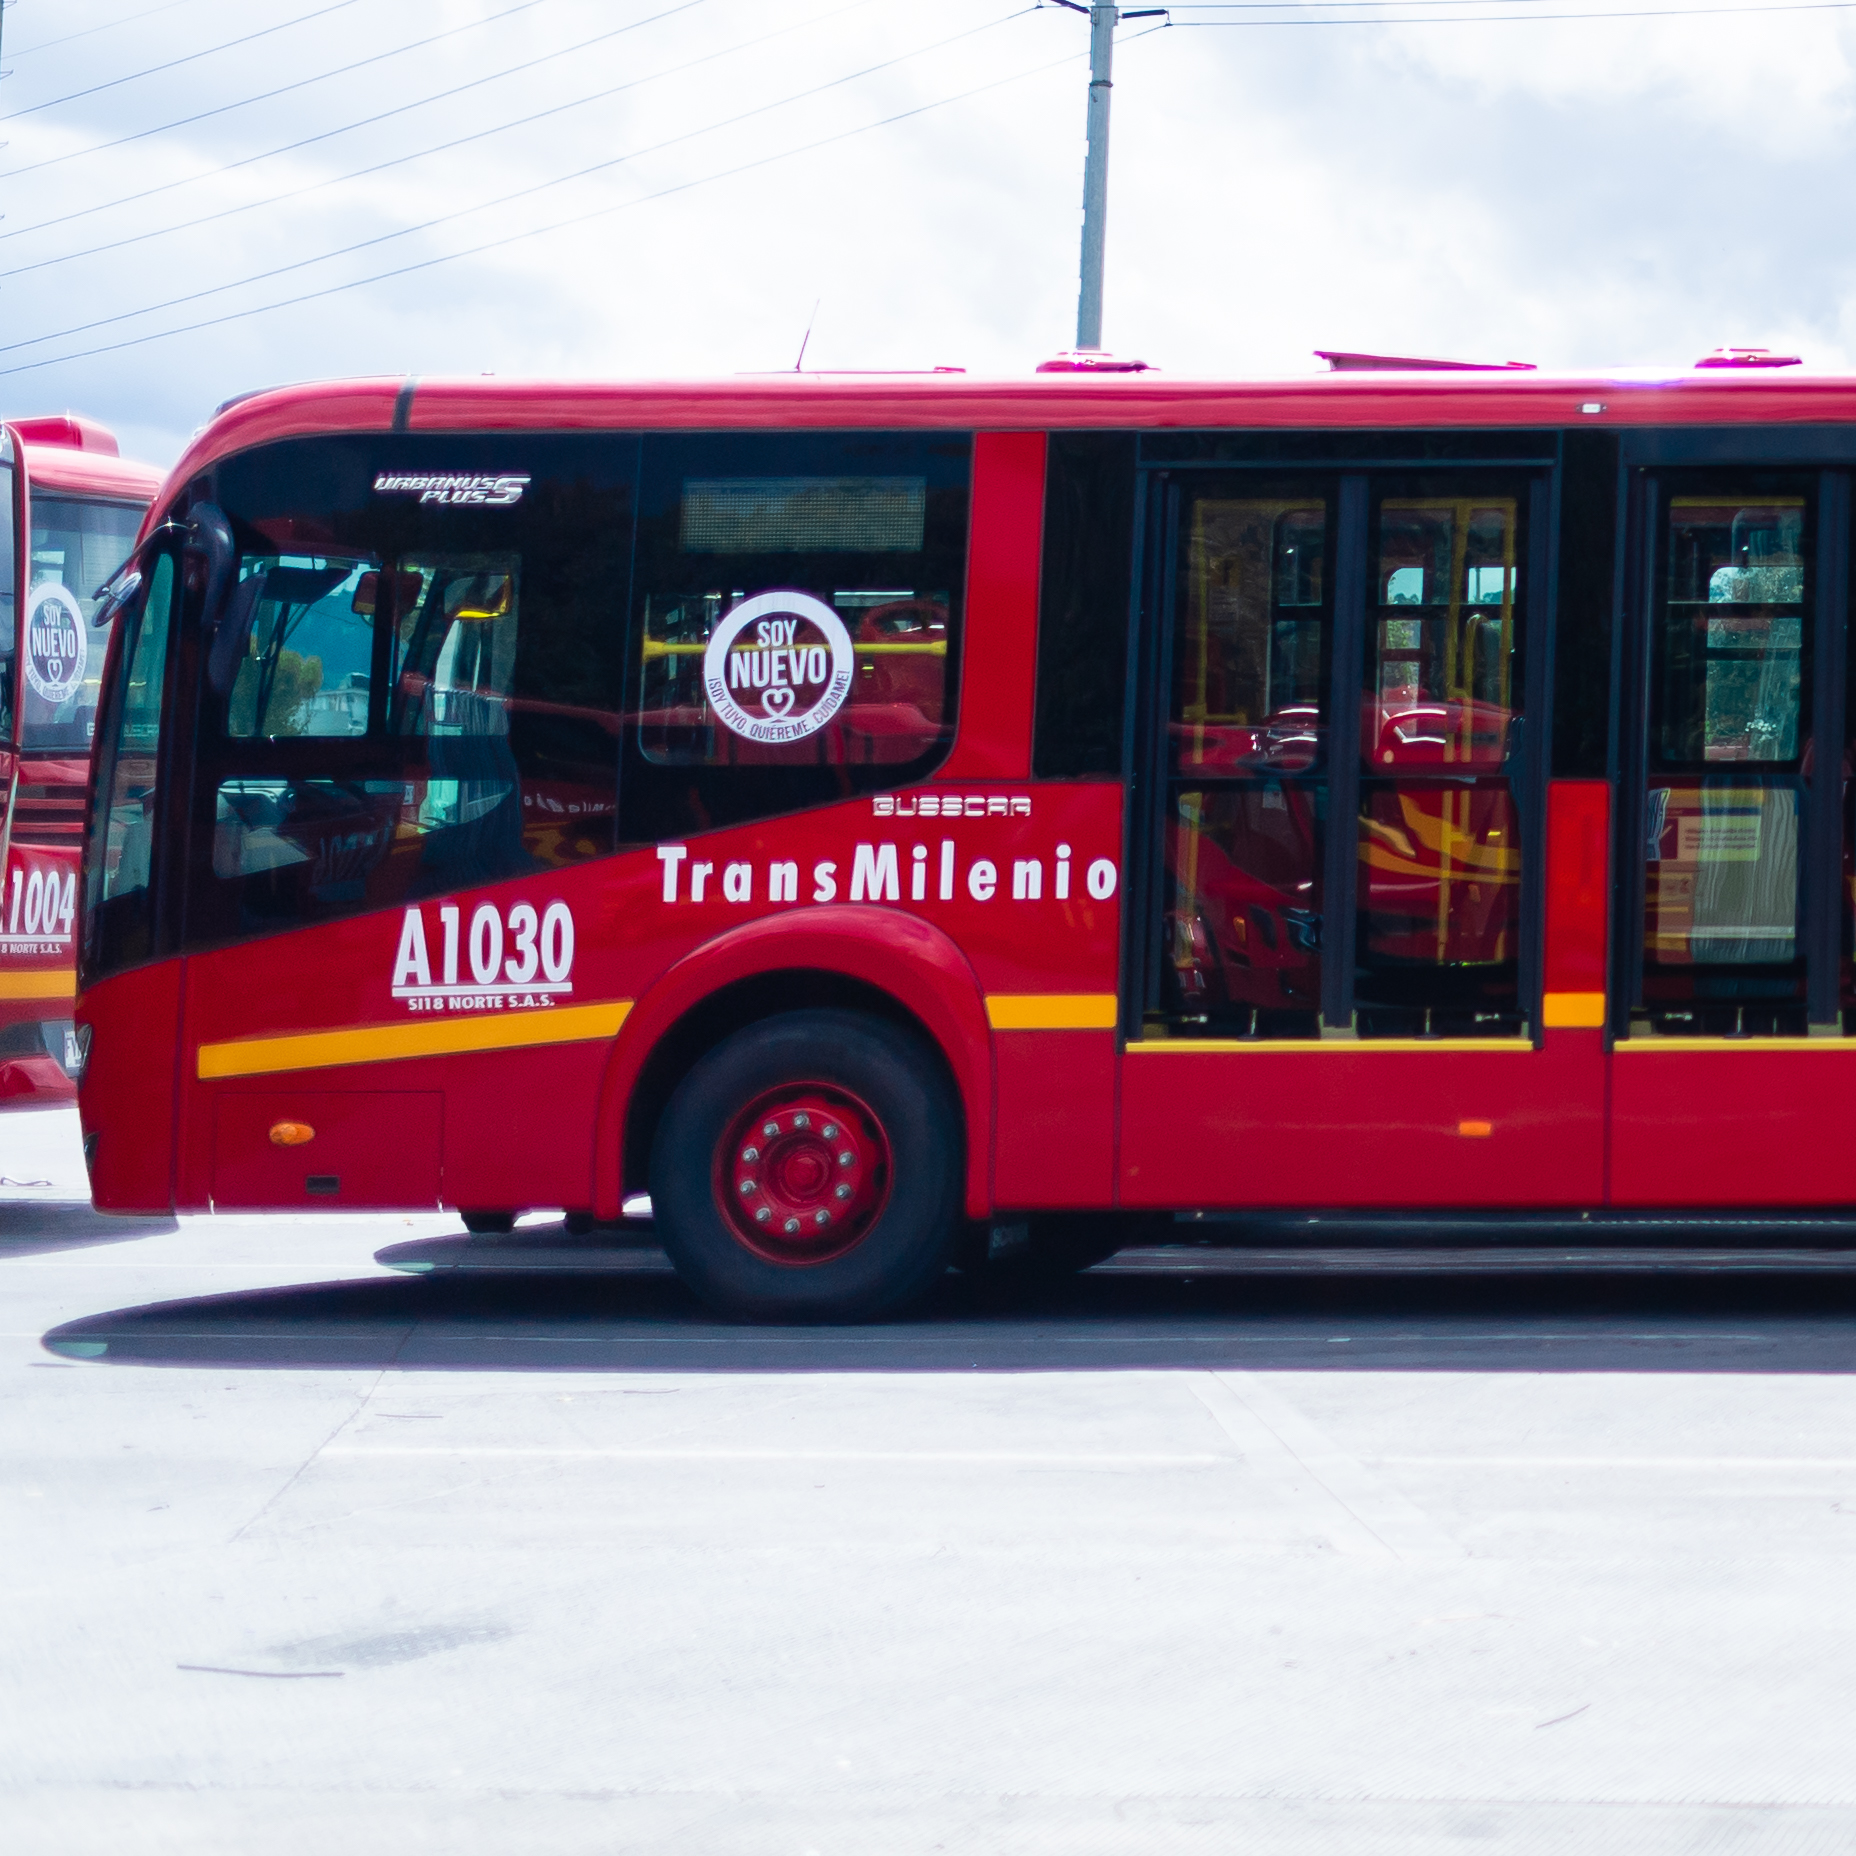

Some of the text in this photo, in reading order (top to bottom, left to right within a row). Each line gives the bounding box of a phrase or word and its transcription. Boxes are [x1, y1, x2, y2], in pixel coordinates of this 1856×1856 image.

[43, 605, 62, 626] SOY
[32, 627, 76, 658] NUEVO
[757, 619, 798, 647] SOY
[731, 647, 827, 689] NUEVO
[873, 795, 1031, 817] BUSSCAR
[657, 841, 1117, 902] TransMilenio
[0, 870, 76, 935] 1004
[10, 944, 38, 954] NORTE
[392, 903, 574, 985] A1030
[449, 995, 504, 1009] NORTE
[508, 993, 555, 1007] S.A.S.
